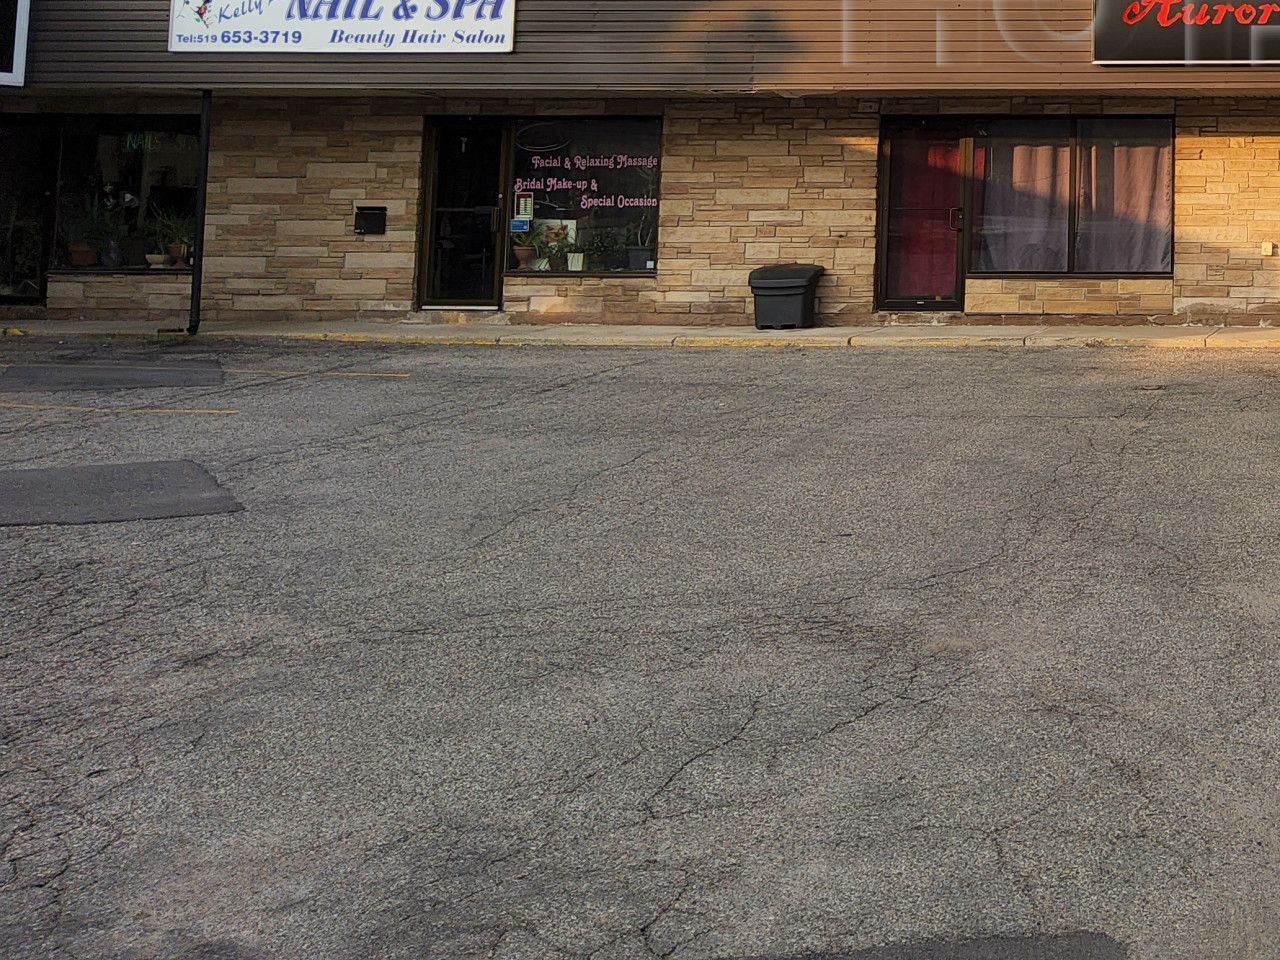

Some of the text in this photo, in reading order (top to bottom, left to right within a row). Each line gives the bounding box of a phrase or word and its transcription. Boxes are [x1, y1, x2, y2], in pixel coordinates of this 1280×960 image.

[221, 30, 302, 44] 653-3719
[328, 29, 506, 48] Beauty Hair Salon
[532, 154, 658, 170] Facial & Relaxing Massage
[514, 178, 598, 192] Bridal Make-up &
[581, 194, 658, 208] Special Occasion
